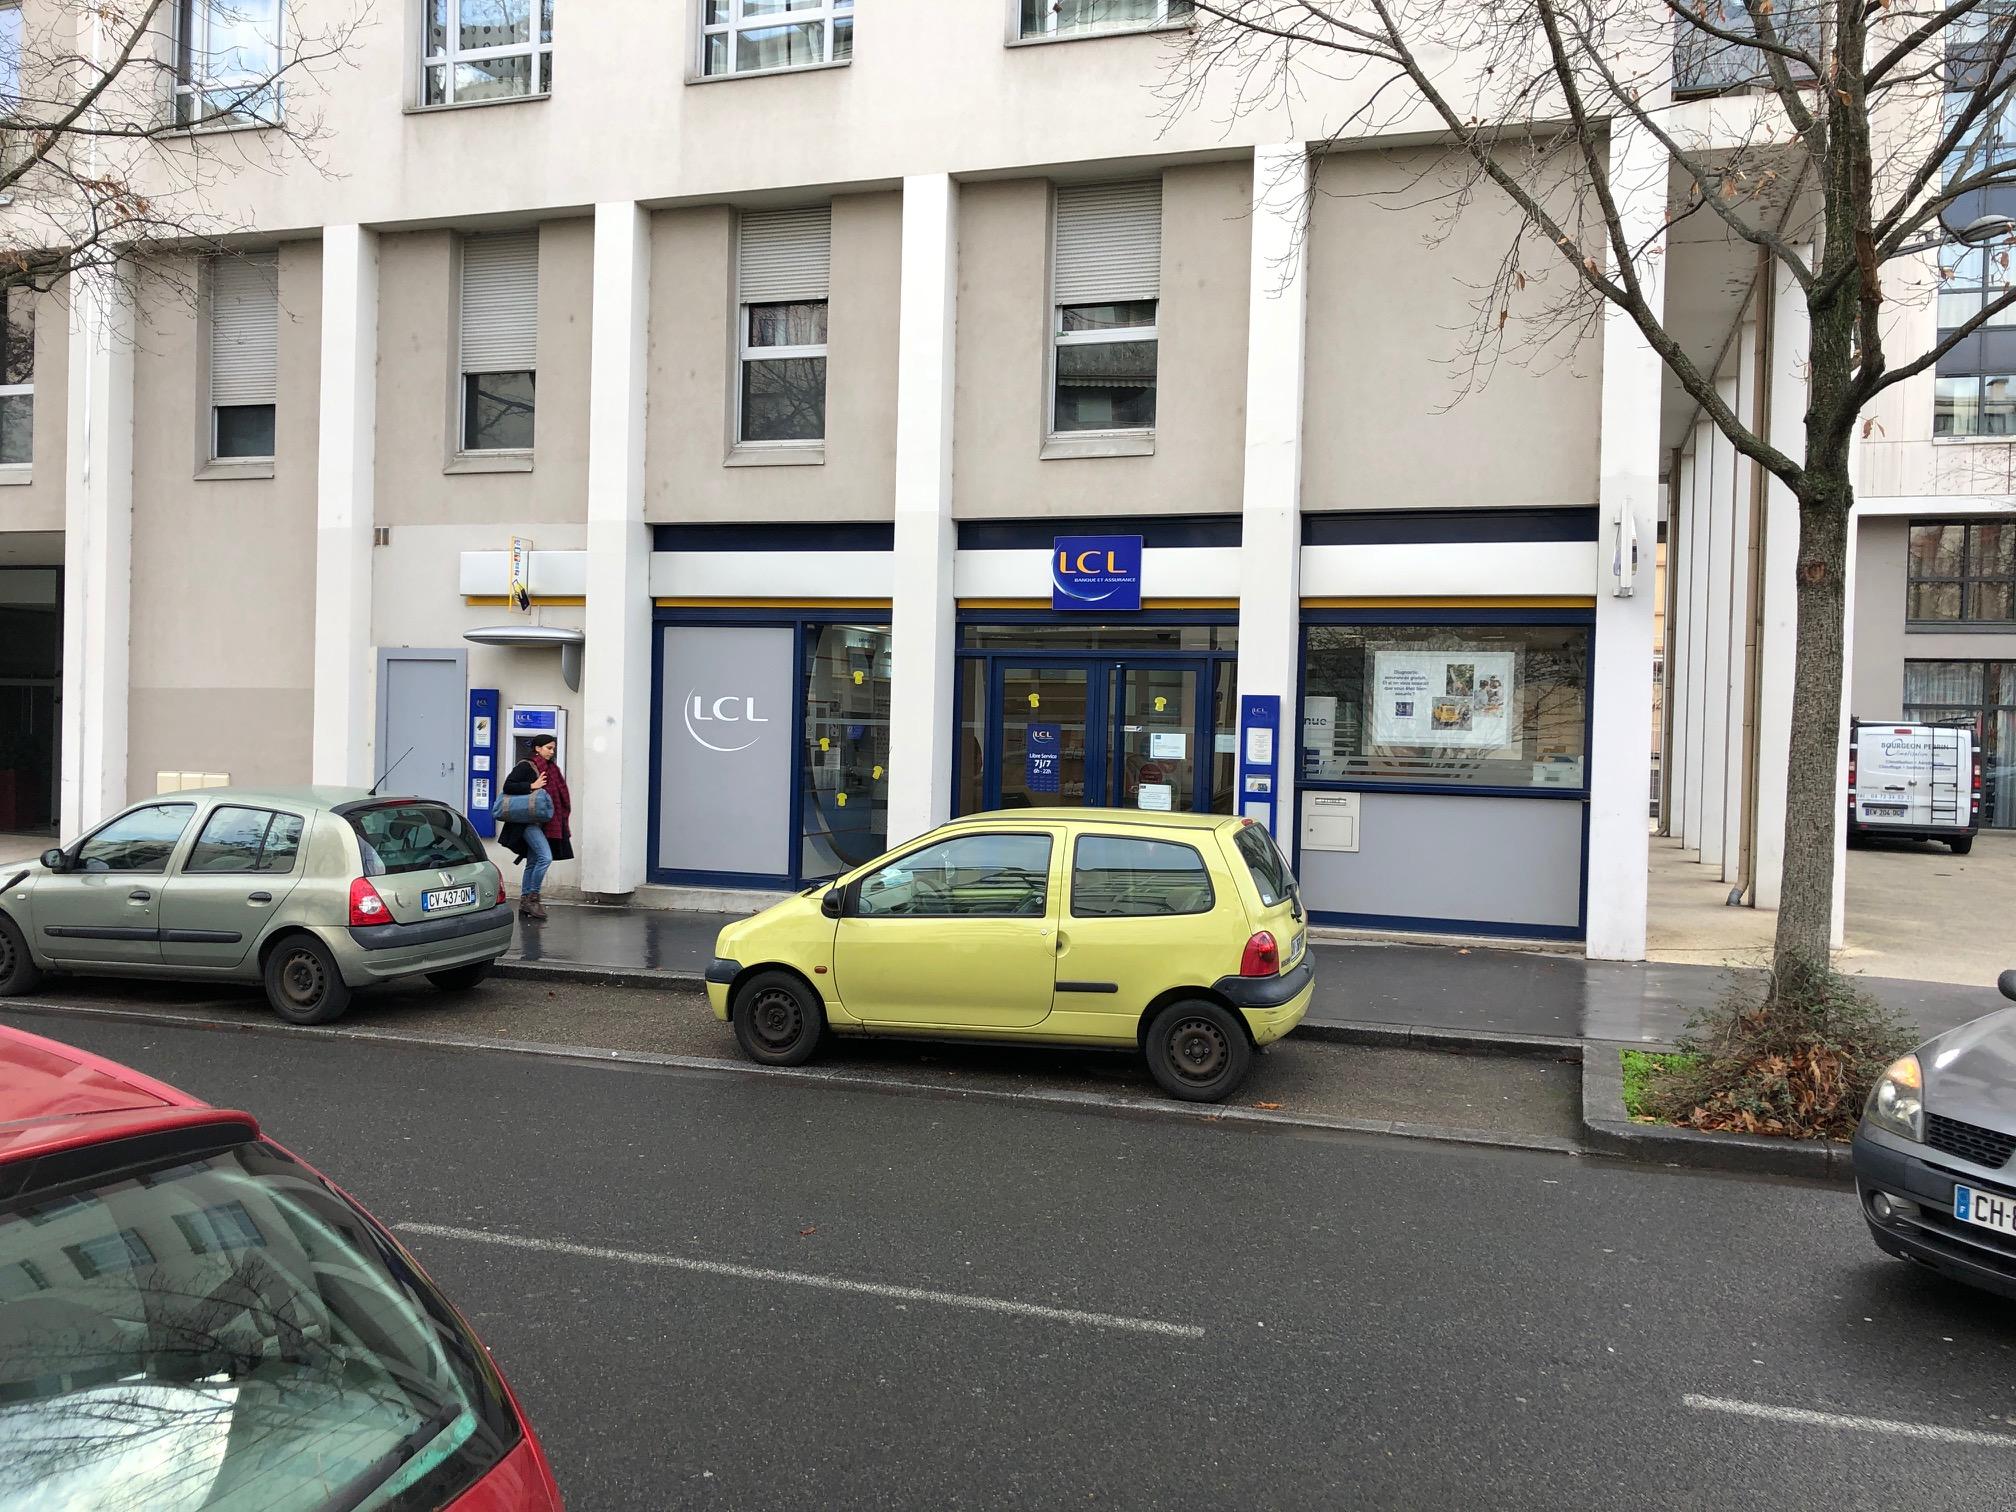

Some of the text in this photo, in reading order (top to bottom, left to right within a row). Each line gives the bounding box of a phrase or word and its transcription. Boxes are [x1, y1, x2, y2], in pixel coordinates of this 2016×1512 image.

[1060, 551, 1127, 574] LCL
[694, 695, 769, 721] LCL
[1881, 742, 1921, 750] BOURGEON
[1034, 759, 1052, 769] 7j/7
[429, 888, 472, 907] CV-437-QN
